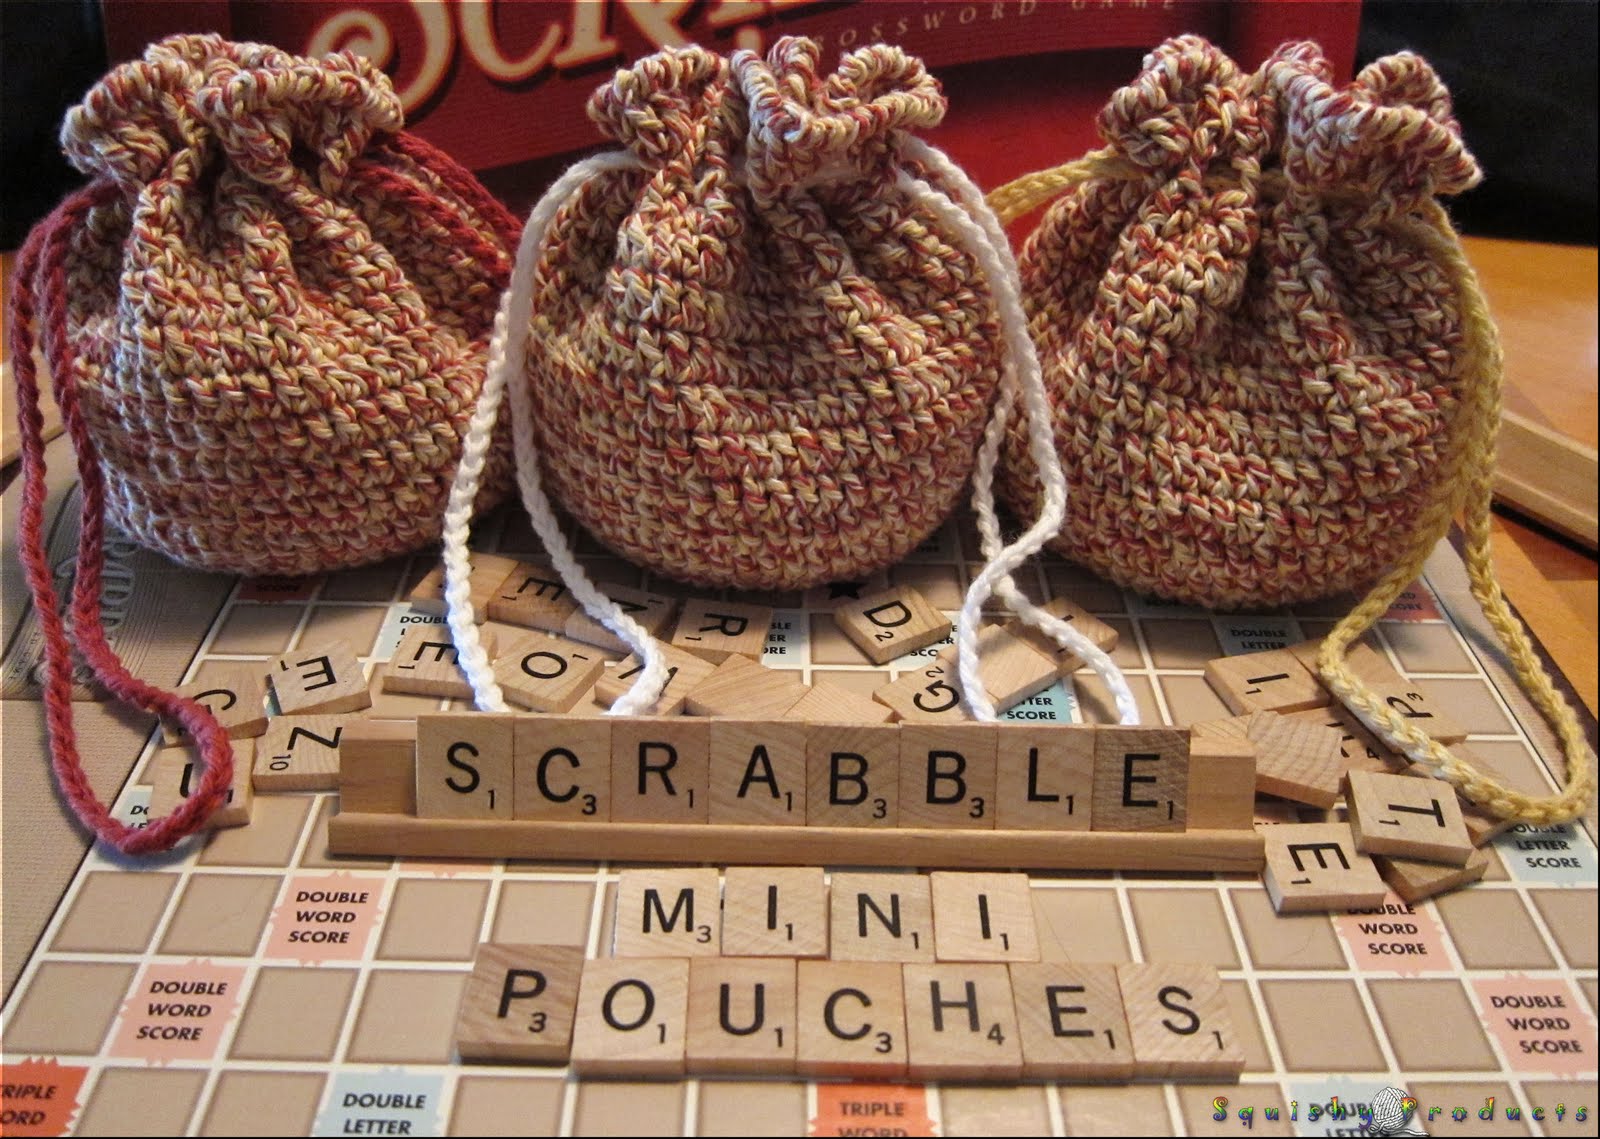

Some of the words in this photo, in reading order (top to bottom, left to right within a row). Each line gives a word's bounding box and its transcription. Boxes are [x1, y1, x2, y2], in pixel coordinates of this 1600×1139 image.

[400, 616, 449, 625] DOUBL
[862, 600, 912, 628] D
[699, 613, 749, 637] R
[875, 630, 894, 642] 2
[1230, 629, 1288, 638] DOUBLE
[520, 651, 568, 679] O
[925, 666, 945, 678] 2
[296, 655, 337, 692] E
[913, 680, 960, 713] G
[1006, 711, 1057, 720] SCORE
[444, 740, 1162, 808] SCRABBLE
[1516, 840, 1571, 851] LETTER
[1287, 842, 1351, 872] E
[1525, 857, 1582, 868] SCORE
[296, 891, 369, 904] DOUBLE
[295, 910, 357, 923] WORD
[642, 885, 992, 941] MINI
[287, 930, 350, 944] SCORE
[1358, 923, 1418, 936] WORD
[1367, 942, 1428, 956] SCORE
[150, 981, 228, 996] DOUBLE
[496, 967, 1201, 1041] POUCHES
[1489, 995, 1567, 1009] DOUBLE
[147, 1003, 212, 1018] WORD
[1506, 1017, 1571, 1031] WORD
[136, 1025, 203, 1041] SCORE
[1519, 1039, 1583, 1054] SCORE
[0, 1084, 57, 1099] RIPLE
[342, 1092, 426, 1109] DOUBLE
[839, 1101, 905, 1117] TRIPLE
[0, 1109, 46, 1126] ORD
[343, 1118, 413, 1135] LETTER
